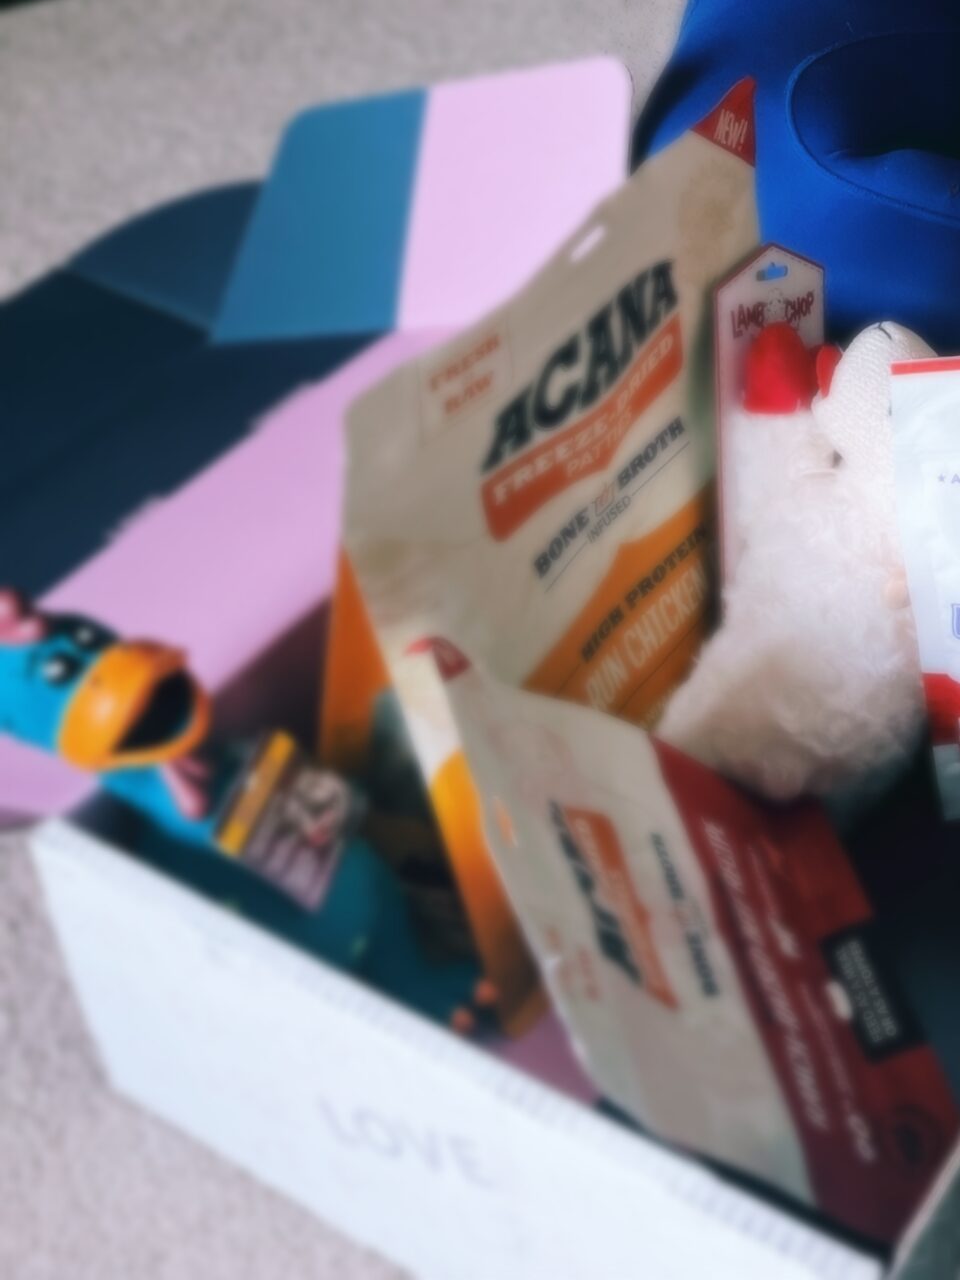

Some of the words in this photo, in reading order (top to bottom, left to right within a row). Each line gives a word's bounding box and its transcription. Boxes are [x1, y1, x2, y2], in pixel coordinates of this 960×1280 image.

[714, 108, 748, 151] NEW!
[481, 258, 679, 476] ACANA
[731, 300, 767, 340] LAMB
[785, 290, 815, 324] CHOP
[533, 505, 590, 580] BONE
[616, 416, 687, 491] BROTH
